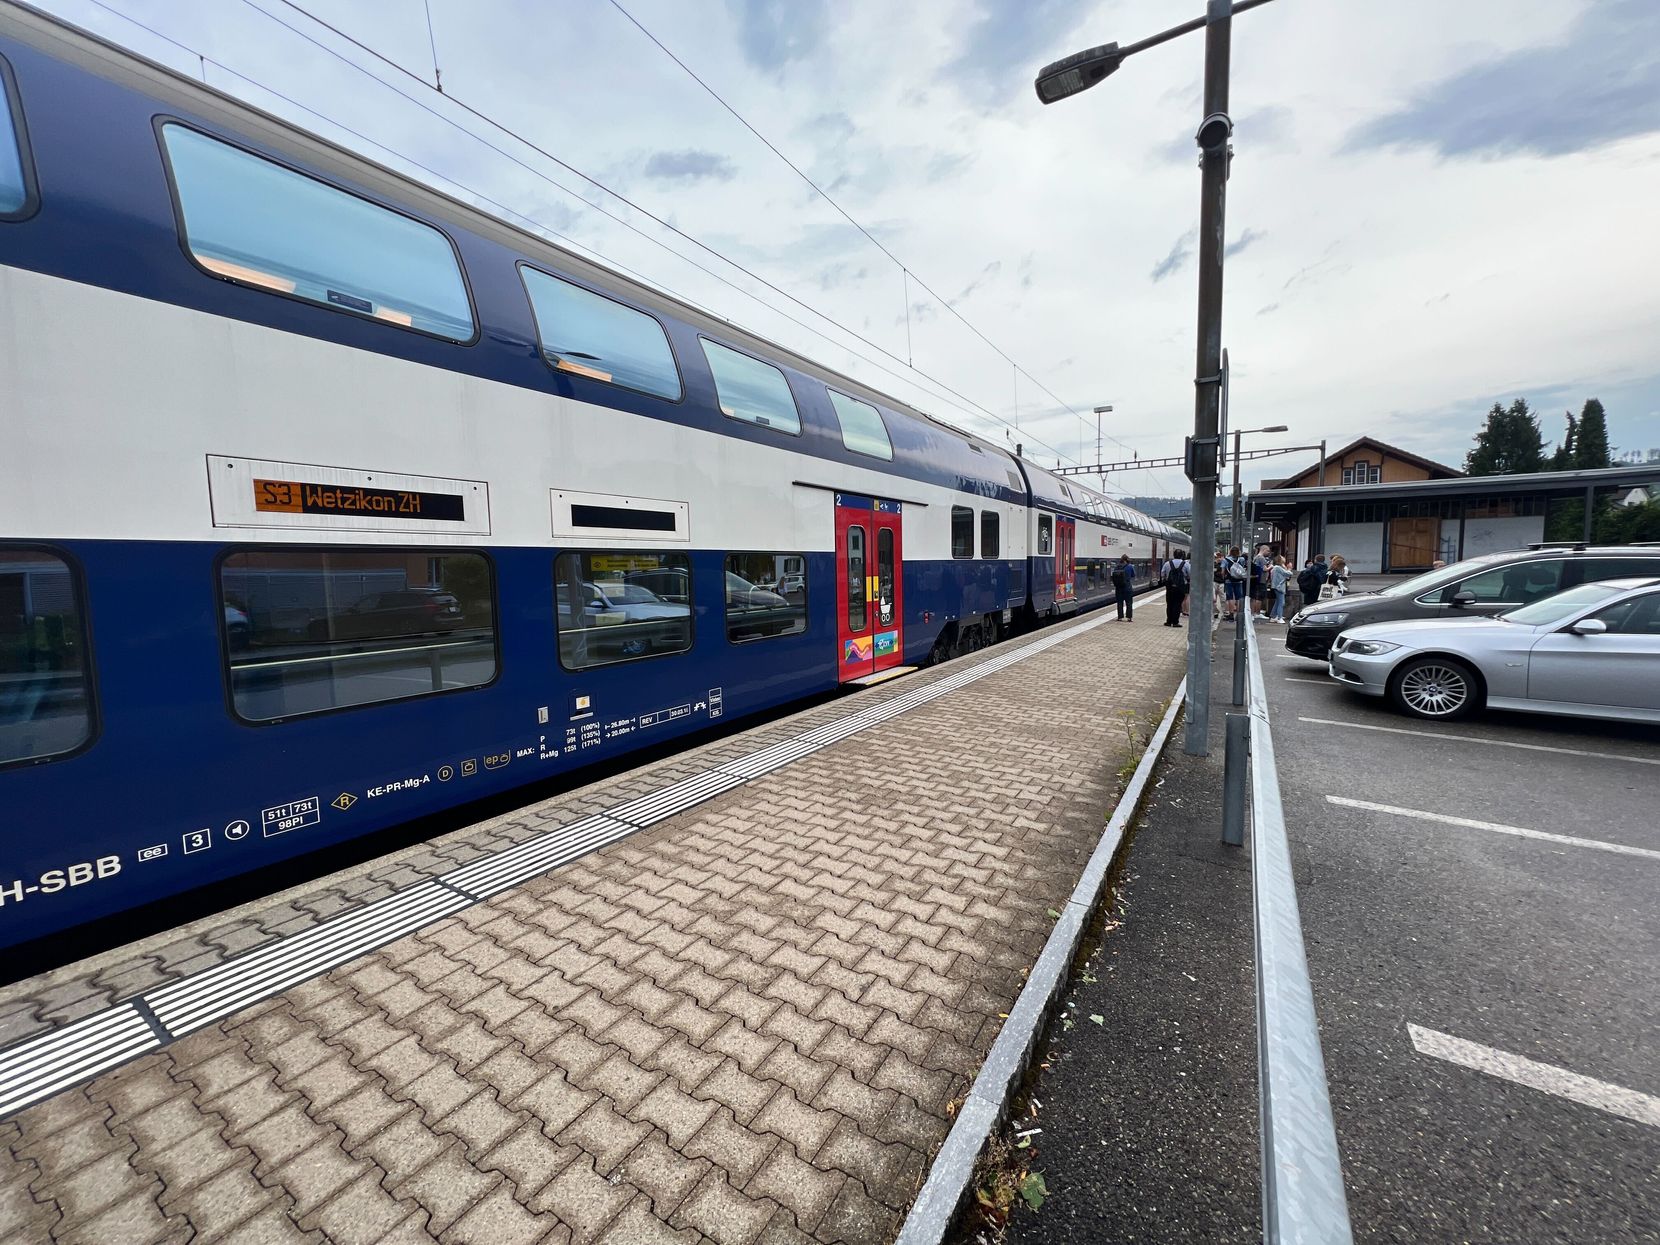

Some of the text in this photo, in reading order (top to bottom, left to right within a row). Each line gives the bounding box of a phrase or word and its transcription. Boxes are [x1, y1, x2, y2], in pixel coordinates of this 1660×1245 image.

[263, 482, 421, 514] S3 Wetzikon ZH
[836, 494, 842, 507] 2
[896, 503, 901, 514] 2
[641, 716, 653, 725] REV
[540, 735, 545, 743] P
[566, 728, 576, 736] 73t
[580, 722, 600, 732] (100%)
[581, 730, 601, 740] (135%)
[611, 727, 630, 737] 20.00m
[516, 747, 535, 758] MAX:
[540, 738, 601, 760] R+Mg 125t (171%)
[367, 774, 430, 798] KE-PR-Mg-A
[340, 795, 350, 807] R
[267, 800, 313, 820] 51t 73t
[191, 833, 204, 848] 3
[143, 845, 162, 858] ee
